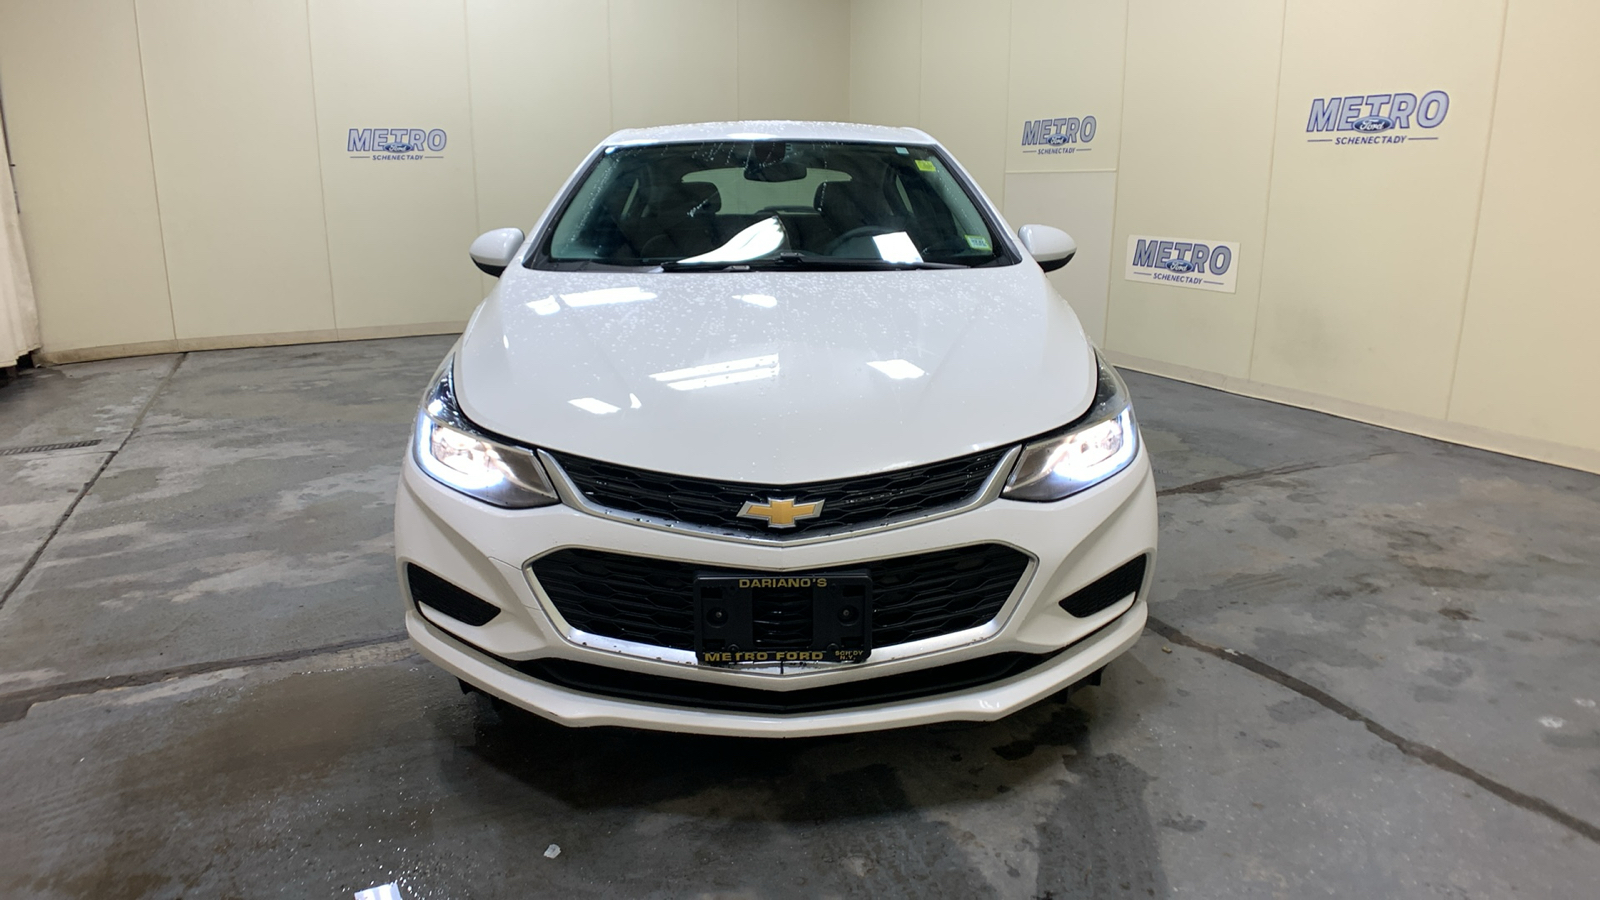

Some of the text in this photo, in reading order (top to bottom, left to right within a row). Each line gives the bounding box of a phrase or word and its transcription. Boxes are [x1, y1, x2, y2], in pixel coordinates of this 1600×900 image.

[1306, 90, 1450, 132] METRO
[1021, 115, 1097, 146] METRO
[347, 128, 447, 152] METRO
[1335, 135, 1407, 145] SCHENECTADY
[1037, 147, 1076, 155] SCHENECTADY
[1132, 239, 1232, 276] METRO
[1152, 272, 1204, 285] SCHENECTADY
[738, 578, 827, 588] DARIANO'S
[704, 652, 824, 661] METRO FORD
